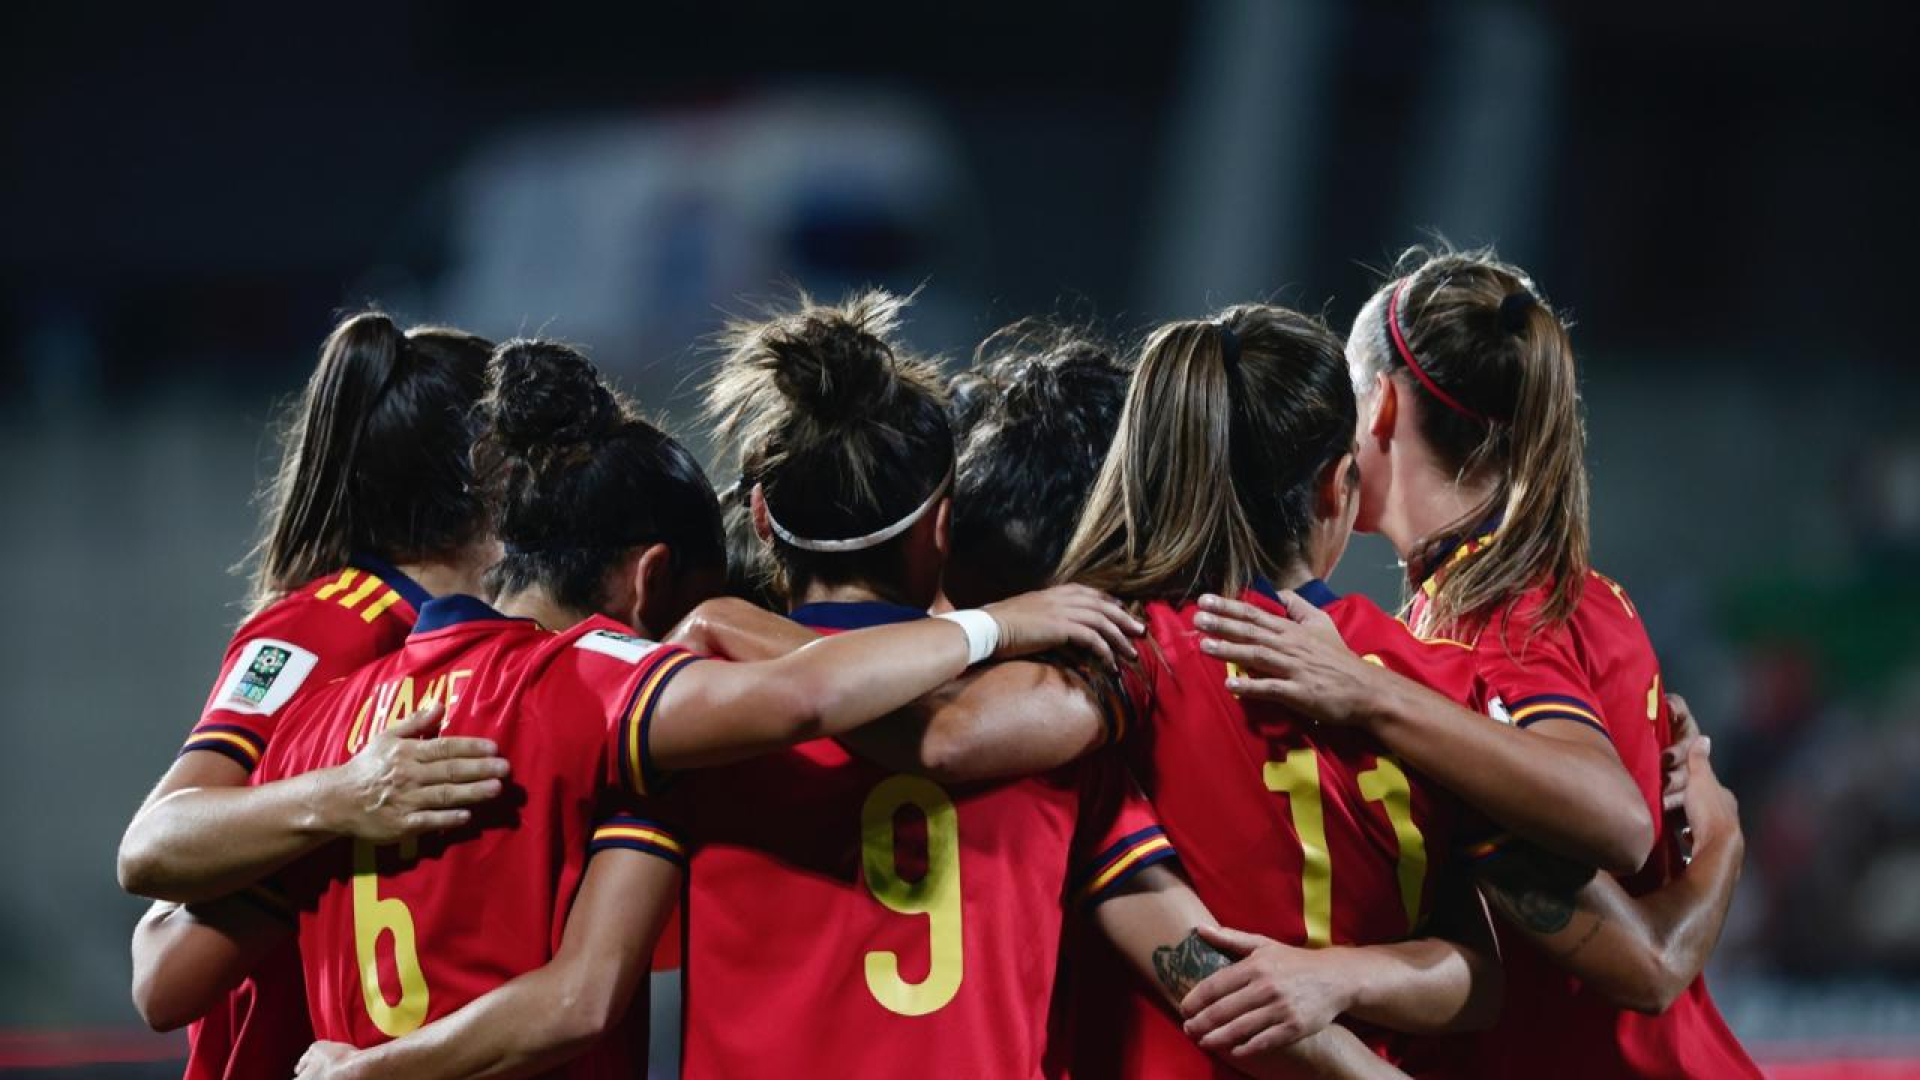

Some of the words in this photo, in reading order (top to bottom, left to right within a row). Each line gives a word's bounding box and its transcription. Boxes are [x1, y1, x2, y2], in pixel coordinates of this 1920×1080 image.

[353, 838, 430, 1038] 6
[861, 773, 963, 1017] 9
[1262, 747, 1429, 947] 11
